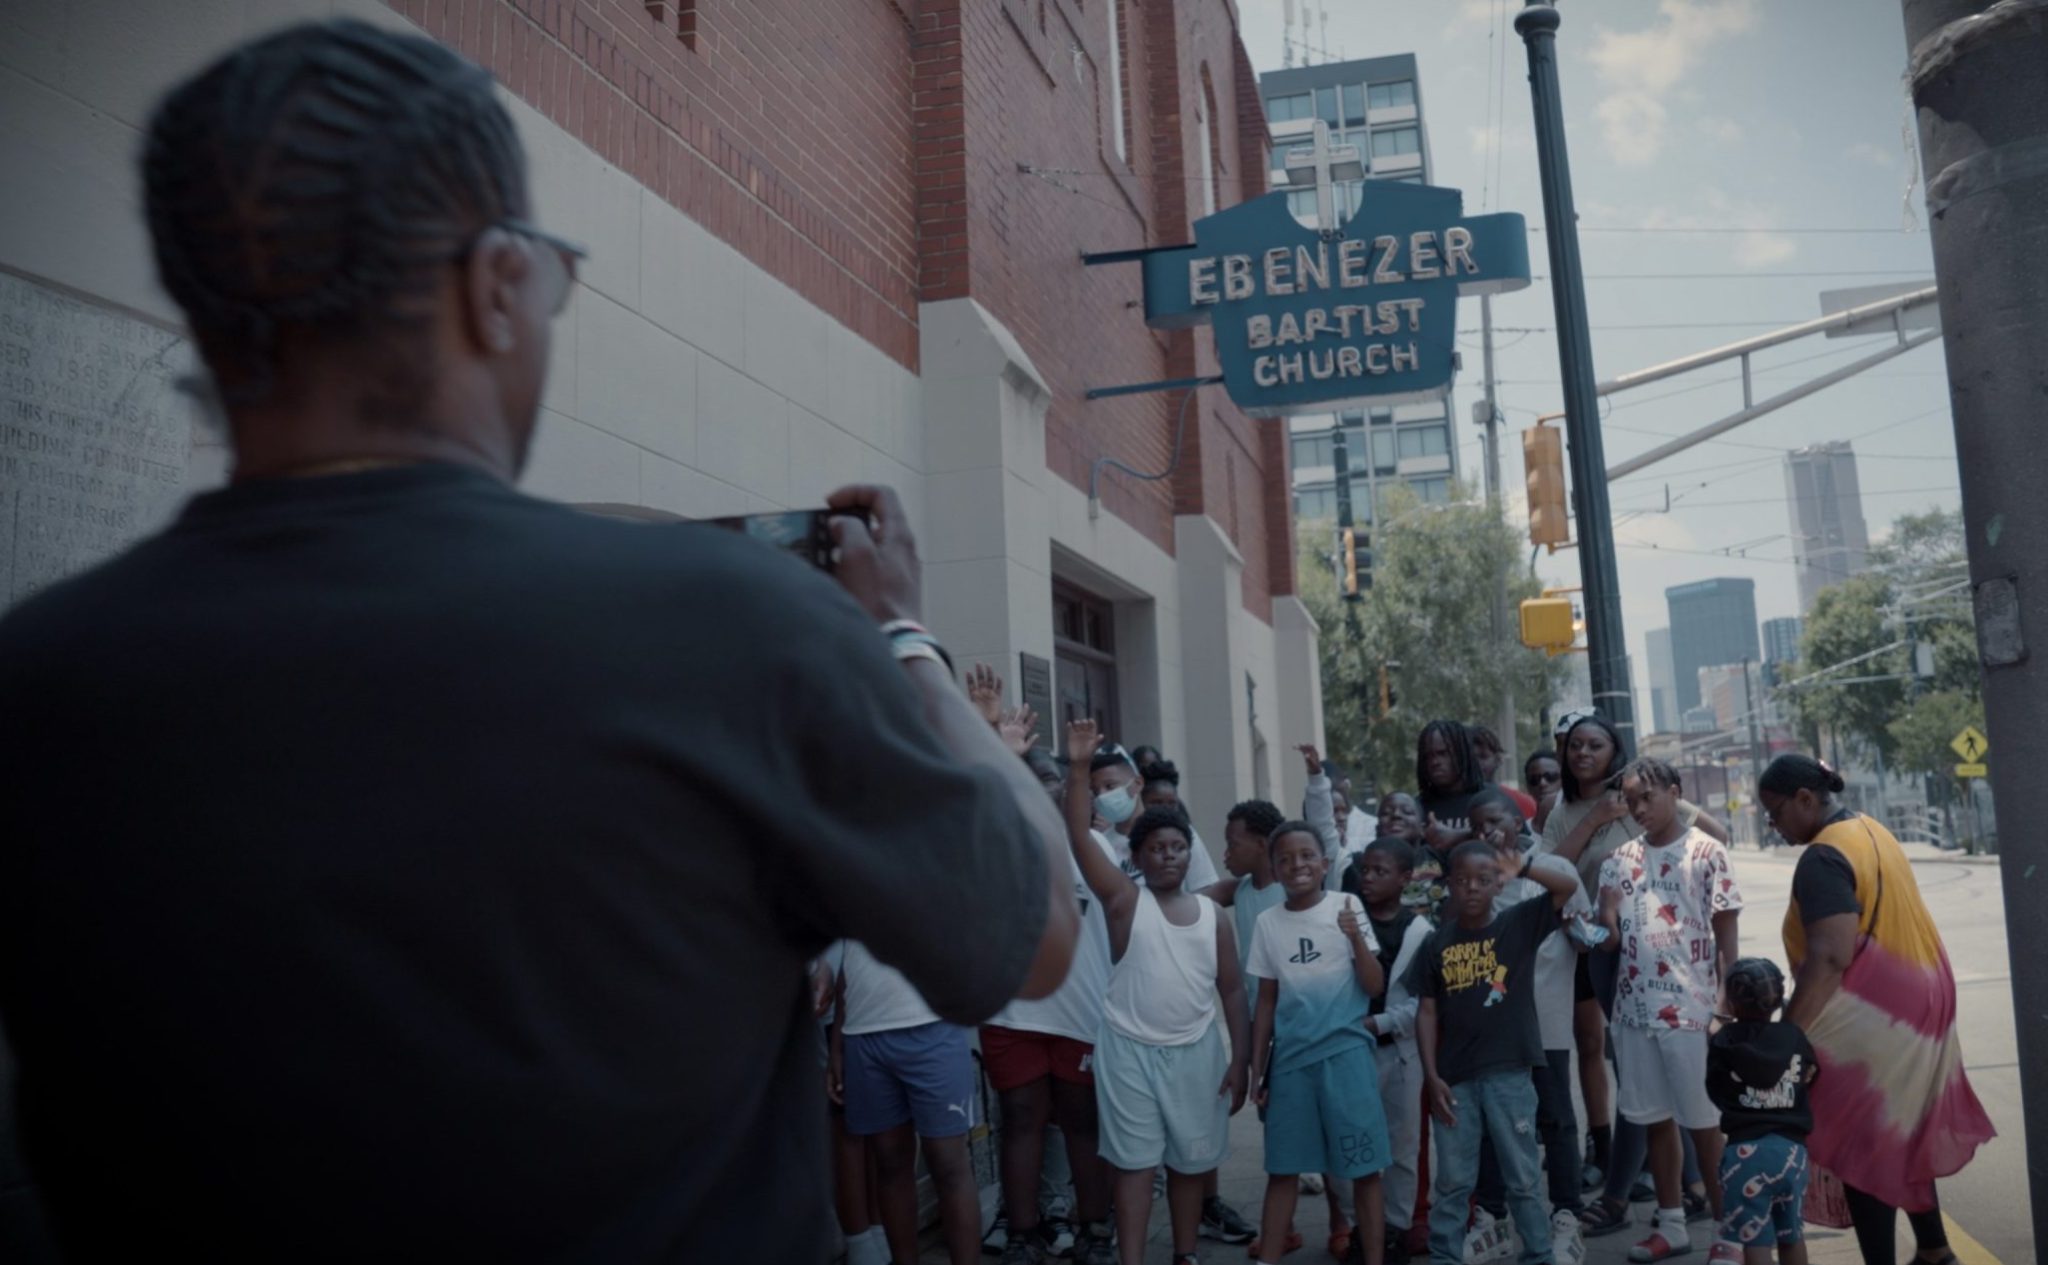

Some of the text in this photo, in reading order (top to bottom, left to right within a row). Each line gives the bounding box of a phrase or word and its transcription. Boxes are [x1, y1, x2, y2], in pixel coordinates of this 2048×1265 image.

[1189, 226, 1480, 306] EBENEZER
[1247, 298, 1425, 349] BAPTIST
[1254, 342, 1420, 387] CHURCH
[1647, 978, 1684, 994] BULLS
